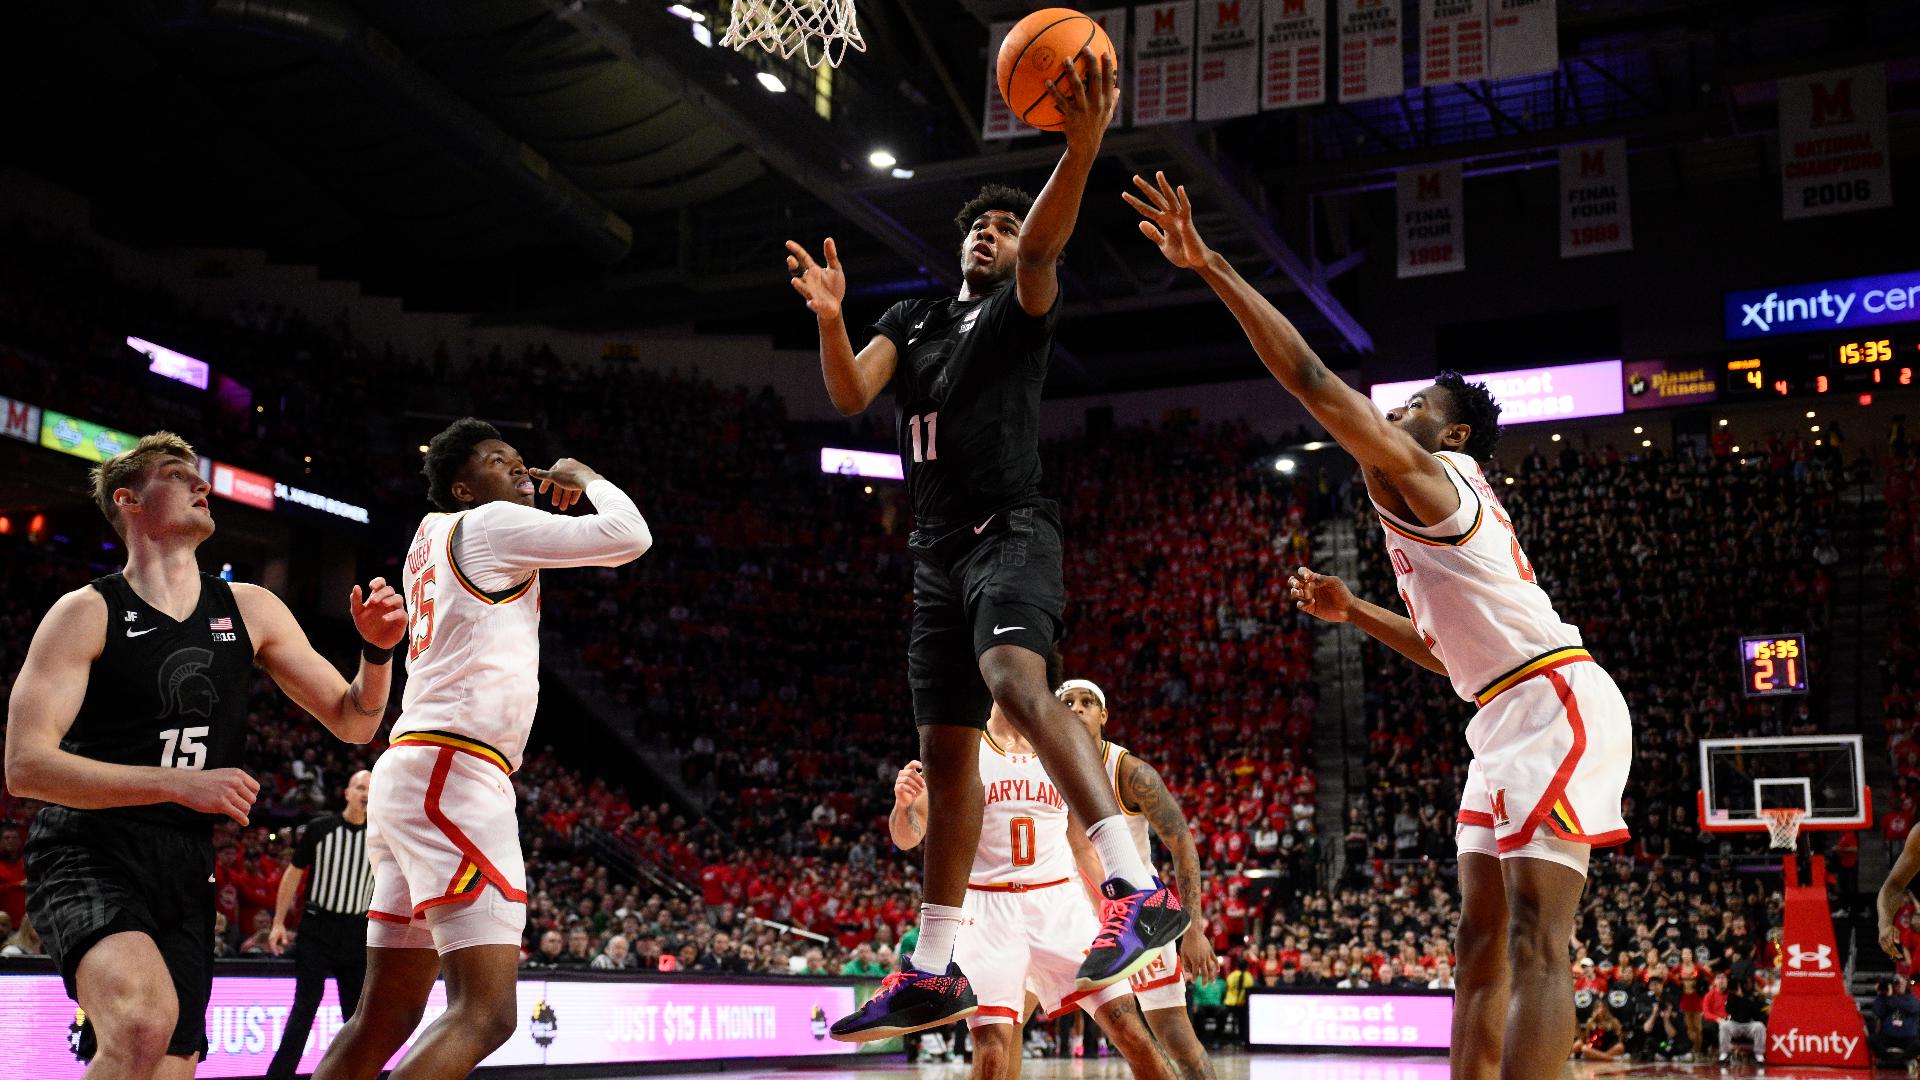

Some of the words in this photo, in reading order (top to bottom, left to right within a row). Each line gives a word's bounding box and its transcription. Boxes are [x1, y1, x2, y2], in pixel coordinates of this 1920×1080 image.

[1154, 8, 1175, 34] M
[1808, 80, 1857, 128] M
[1580, 150, 1606, 177] M
[1416, 173, 1440, 201] M
[1569, 185, 1620, 204] FINAL
[1803, 179, 1870, 208] 2006
[1405, 207, 1453, 224] FINAL
[1571, 201, 1618, 218] FOUR
[1408, 223, 1452, 240] FOUR
[1741, 288, 1856, 332] xfinity
[1840, 340, 1893, 364] 15:35
[1652, 369, 1705, 388] planet
[1660, 380, 1716, 397] fitness
[1747, 370, 1762, 389] 4
[1775, 380, 1787, 395] 4
[1816, 375, 1828, 393] 3
[1899, 367, 1912, 384] 2
[6, 399, 31, 434] M
[908, 411, 938, 463] 11
[408, 538, 433, 575] QUEEN
[409, 564, 436, 663] 25
[1754, 639, 1799, 660] 15:35
[1754, 659, 1796, 690] 21
[159, 726, 210, 770] 15
[1010, 816, 1036, 867] 0
[608, 1005, 658, 1042] JUST
[663, 1001, 694, 1045] $15
[699, 1006, 714, 1041] A
[717, 1006, 777, 1041] MONTH
[1284, 1001, 1395, 1024] planet
[207, 1005, 289, 1055] JUST
[1297, 1020, 1419, 1042] fitness
[1771, 1028, 1860, 1060] xfinity
